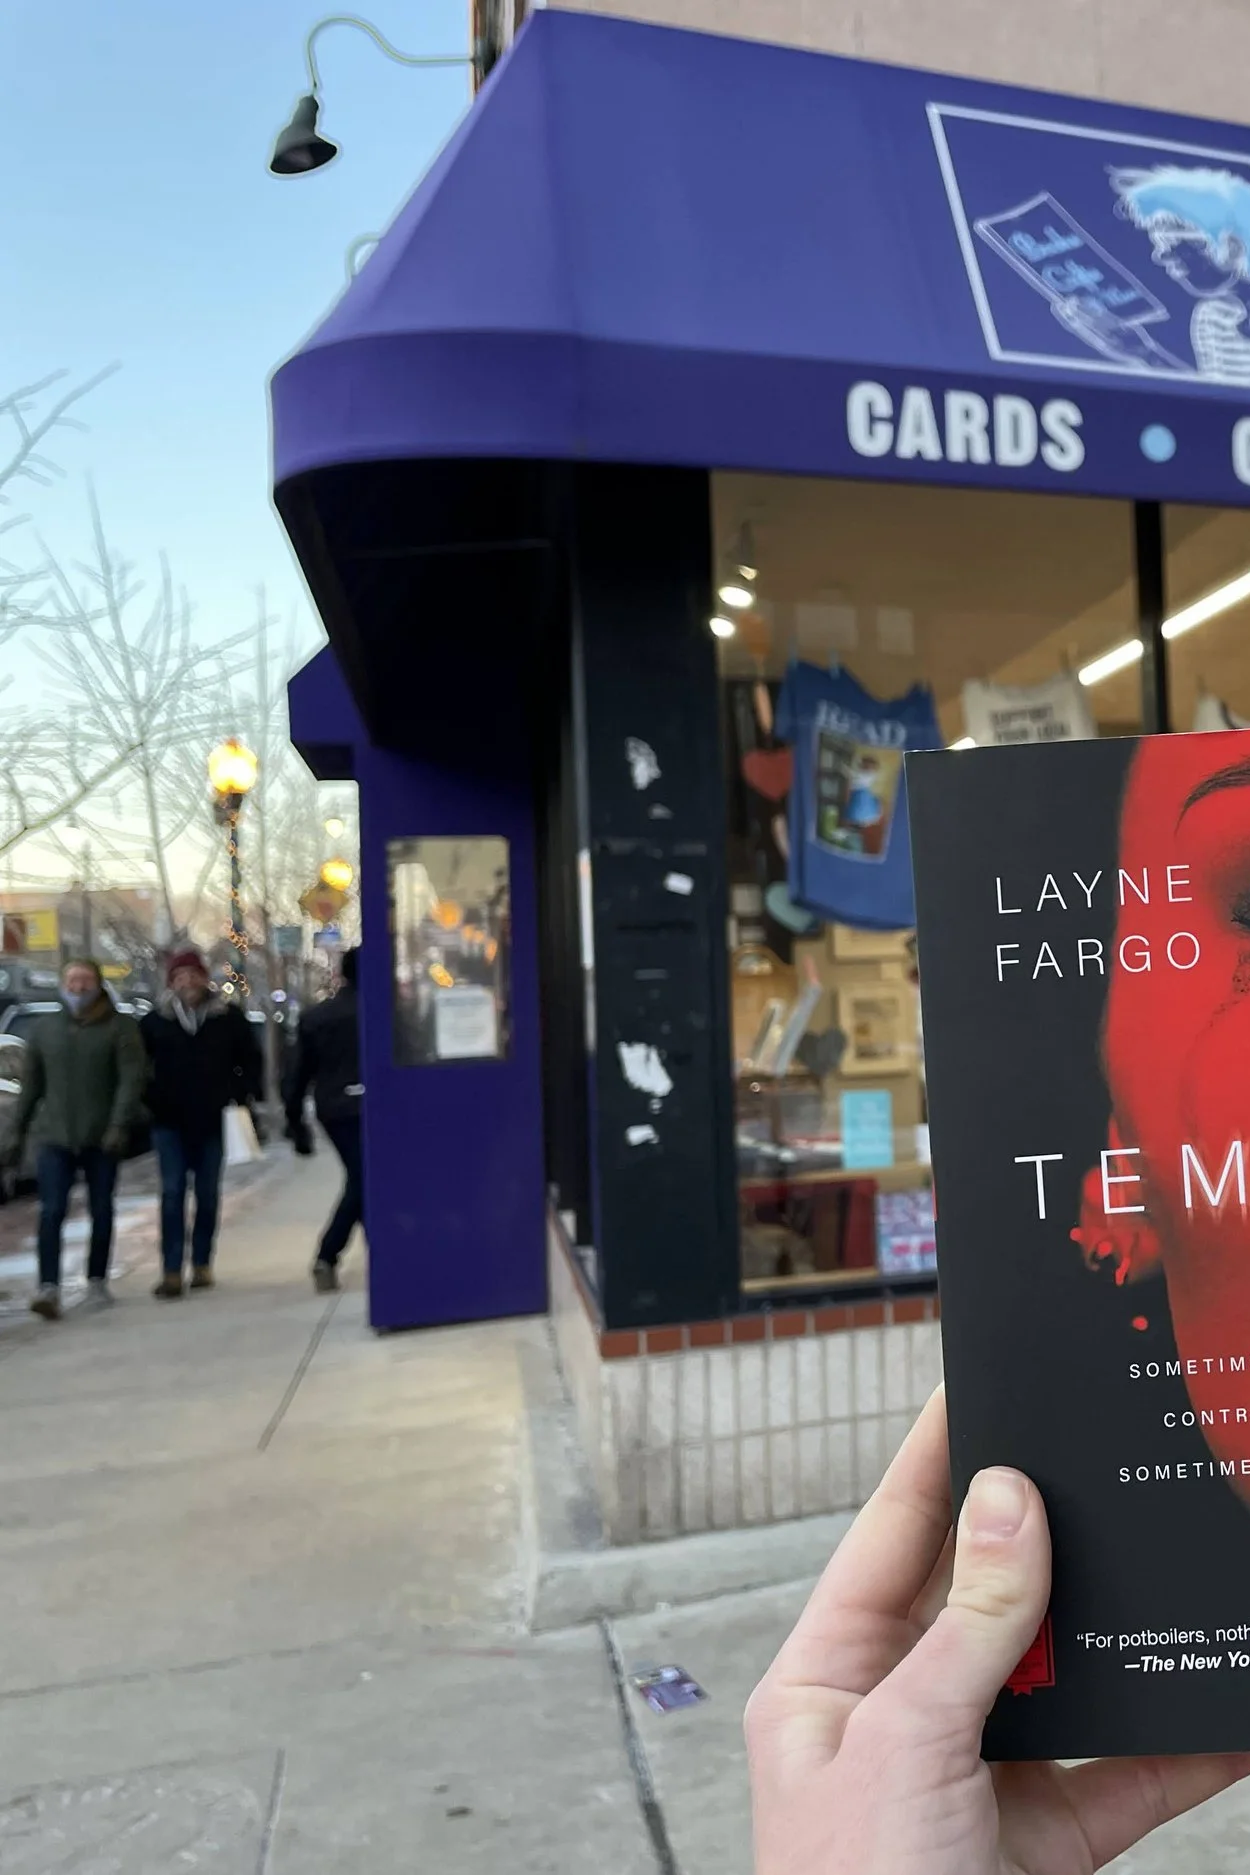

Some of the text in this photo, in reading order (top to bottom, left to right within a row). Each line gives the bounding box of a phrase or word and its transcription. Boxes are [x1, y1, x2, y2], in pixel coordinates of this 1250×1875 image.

[847, 382, 1085, 471] CARDS
[996, 864, 1193, 914] LAYNE
[996, 931, 1200, 982] FARGO
[1118, 1627, 1210, 1651] potboilers,
[1180, 1653, 1223, 1671] New
